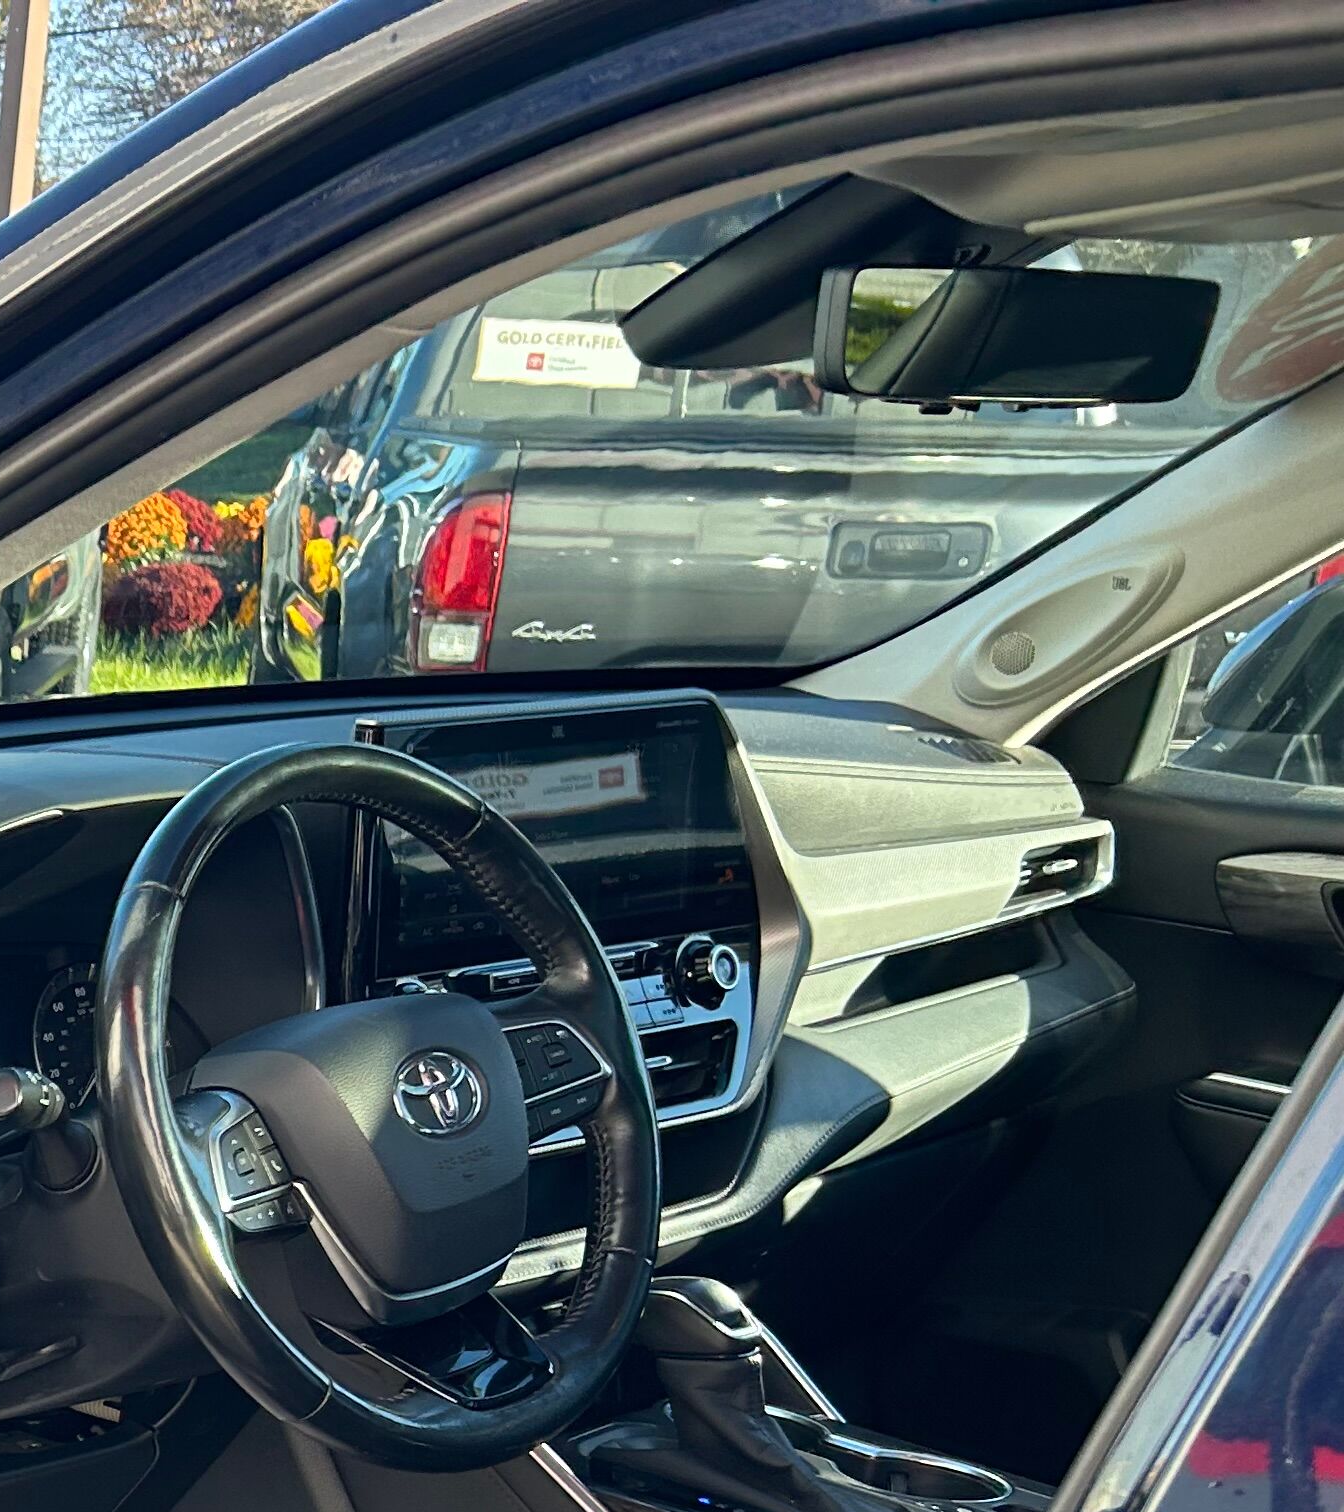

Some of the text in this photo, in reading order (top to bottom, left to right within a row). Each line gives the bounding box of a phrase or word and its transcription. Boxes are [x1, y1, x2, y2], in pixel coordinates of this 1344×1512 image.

[497, 331, 543, 345] GOLD
[1112, 575, 1132, 591] JBL
[52, 1002, 64, 1012] 60
